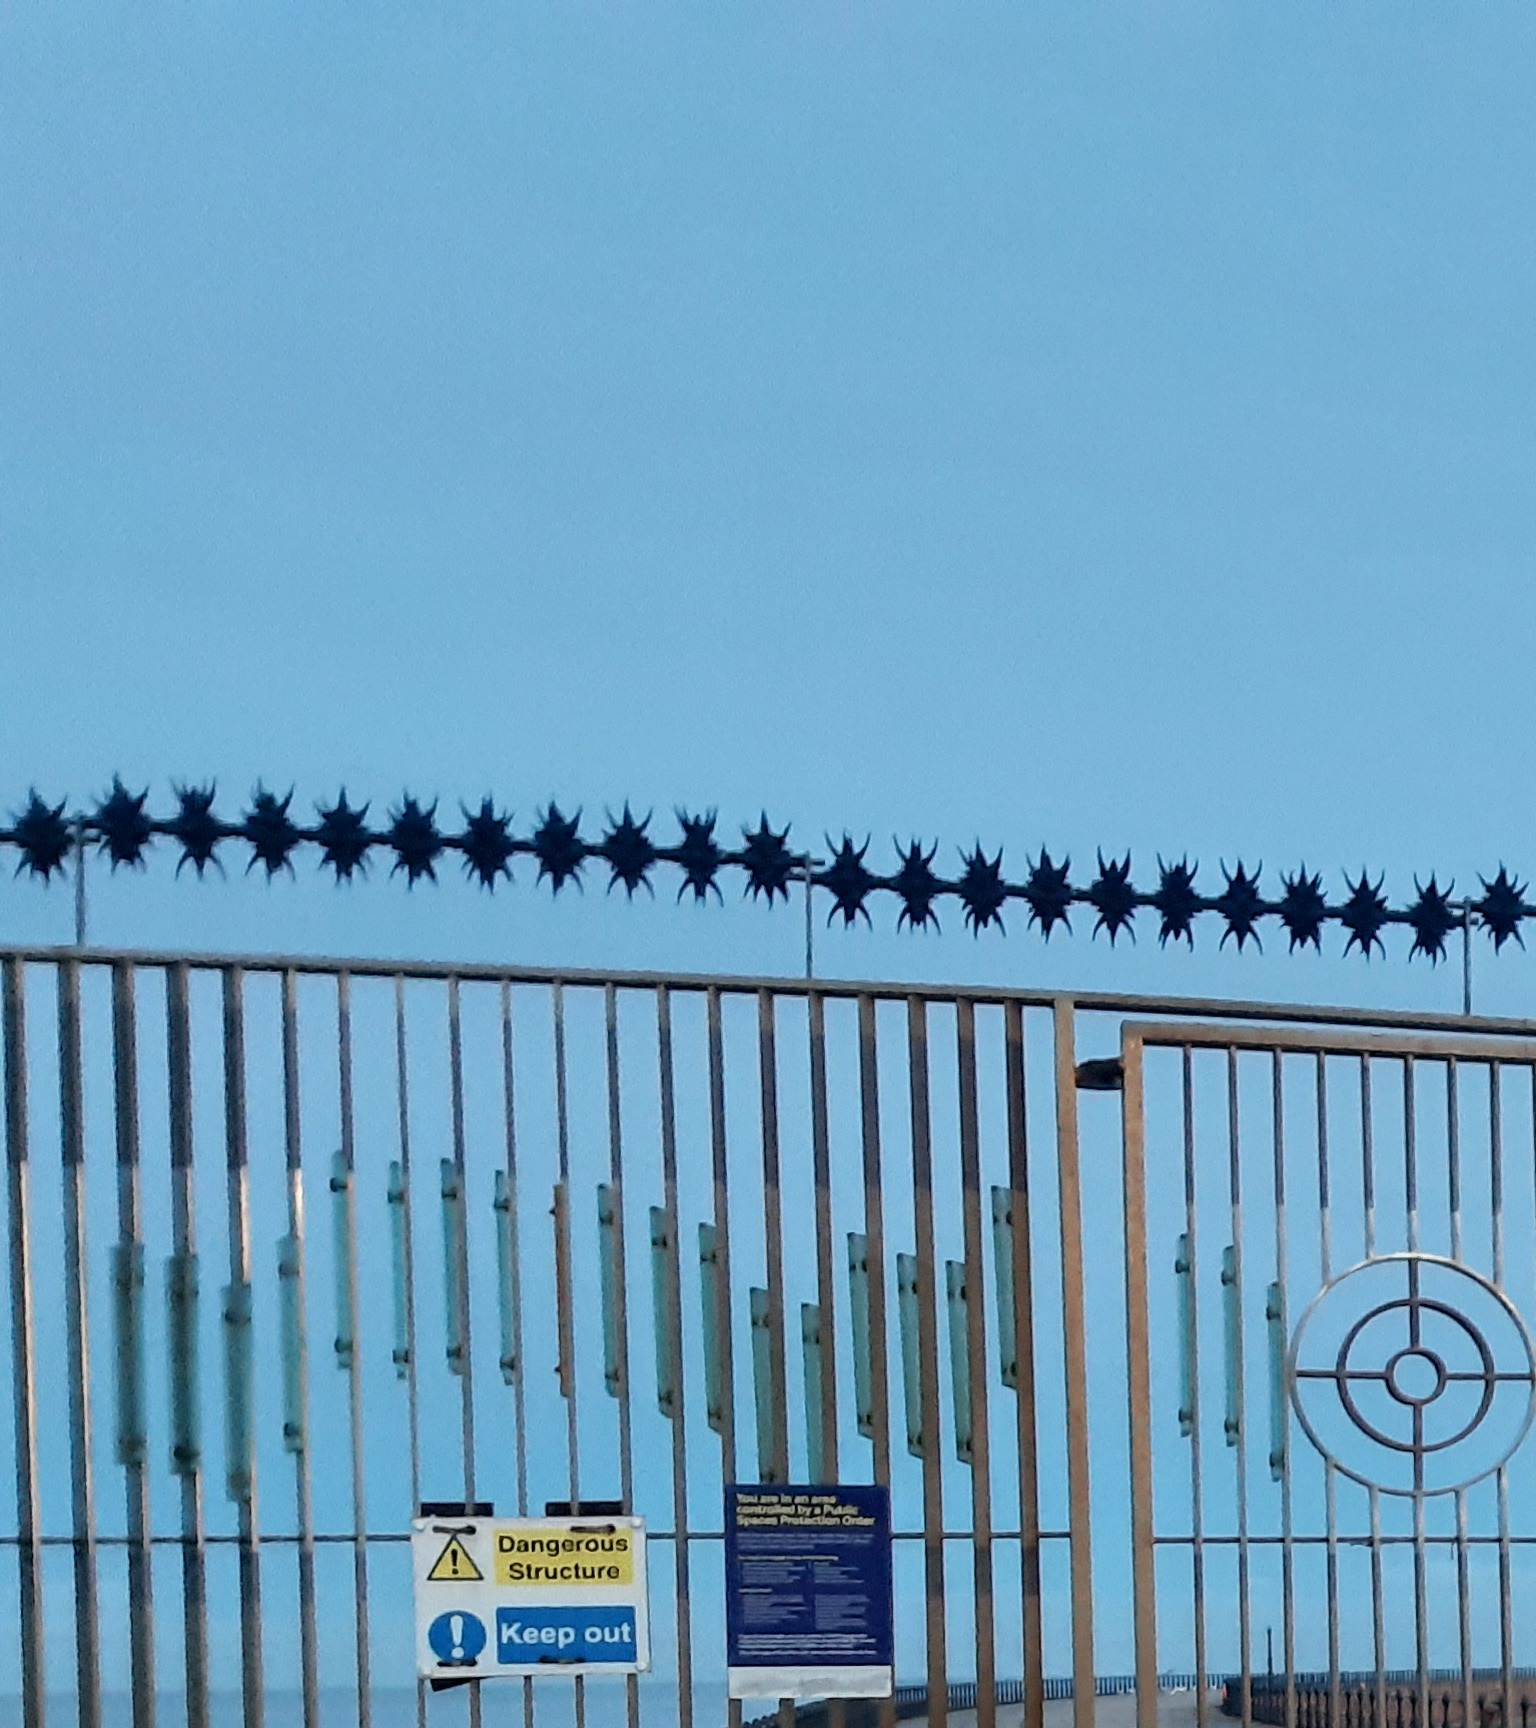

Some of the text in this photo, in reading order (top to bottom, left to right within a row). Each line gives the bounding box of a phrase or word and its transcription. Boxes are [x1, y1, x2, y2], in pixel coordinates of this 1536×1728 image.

[797, 1504, 812, 1516] by
[823, 1504, 859, 1515] Public
[779, 1515, 840, 1526] Protection
[842, 1515, 876, 1525] Order
[498, 1535, 629, 1557] Dangerous
[508, 1562, 620, 1580] Structure
[501, 1622, 632, 1649] Keep out
